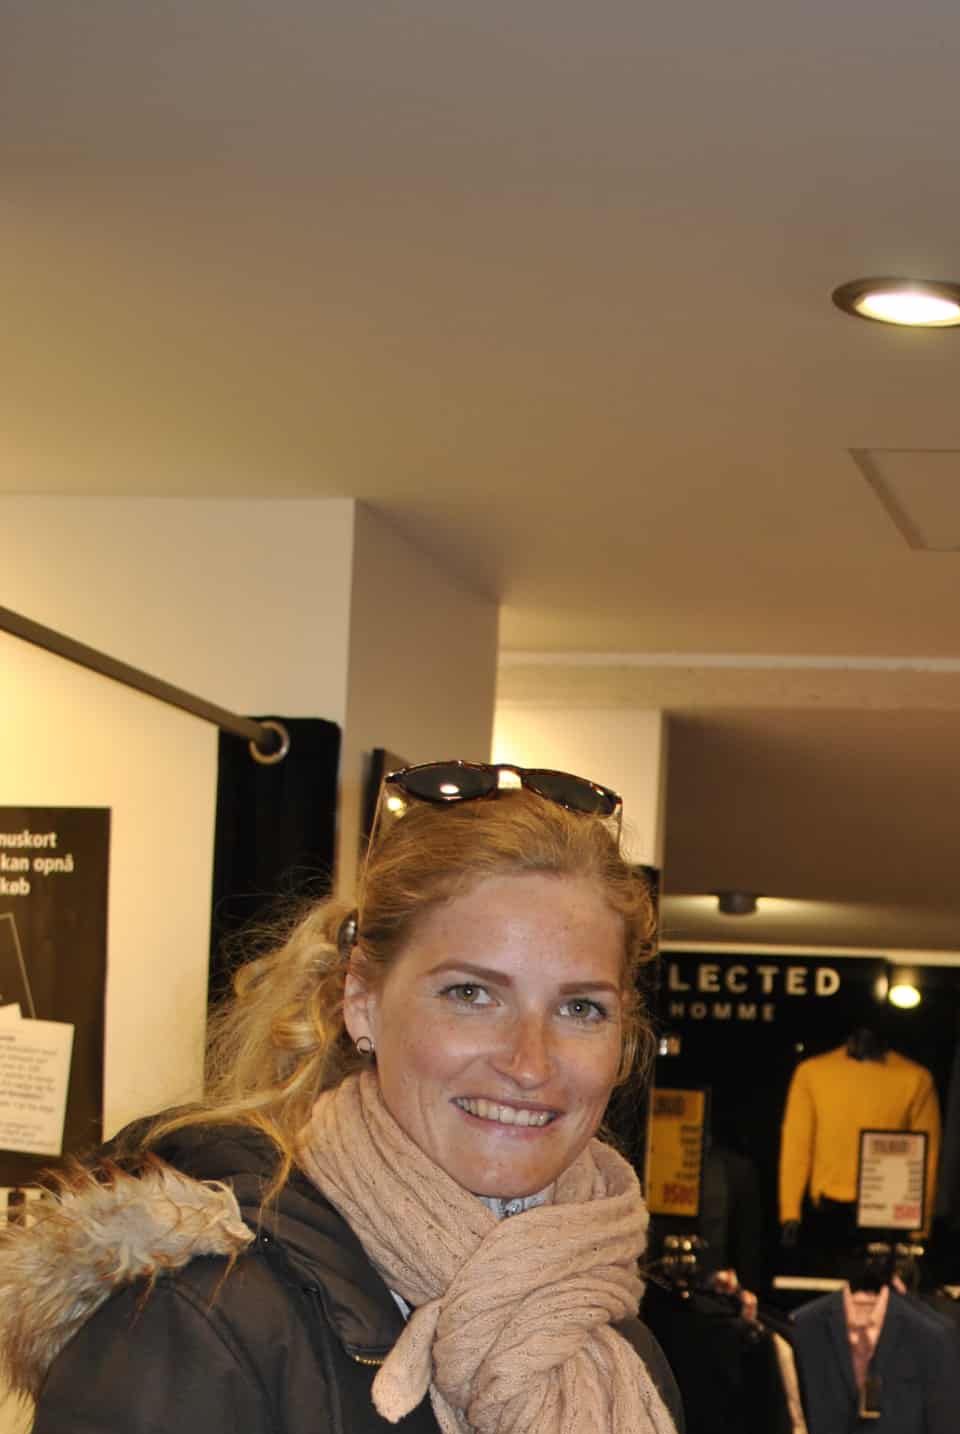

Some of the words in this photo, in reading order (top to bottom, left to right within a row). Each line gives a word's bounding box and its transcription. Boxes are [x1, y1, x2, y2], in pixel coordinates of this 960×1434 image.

[0, 853, 30, 872] kan
[33, 853, 74, 877] opnå
[671, 1001, 775, 1022] HOMME
